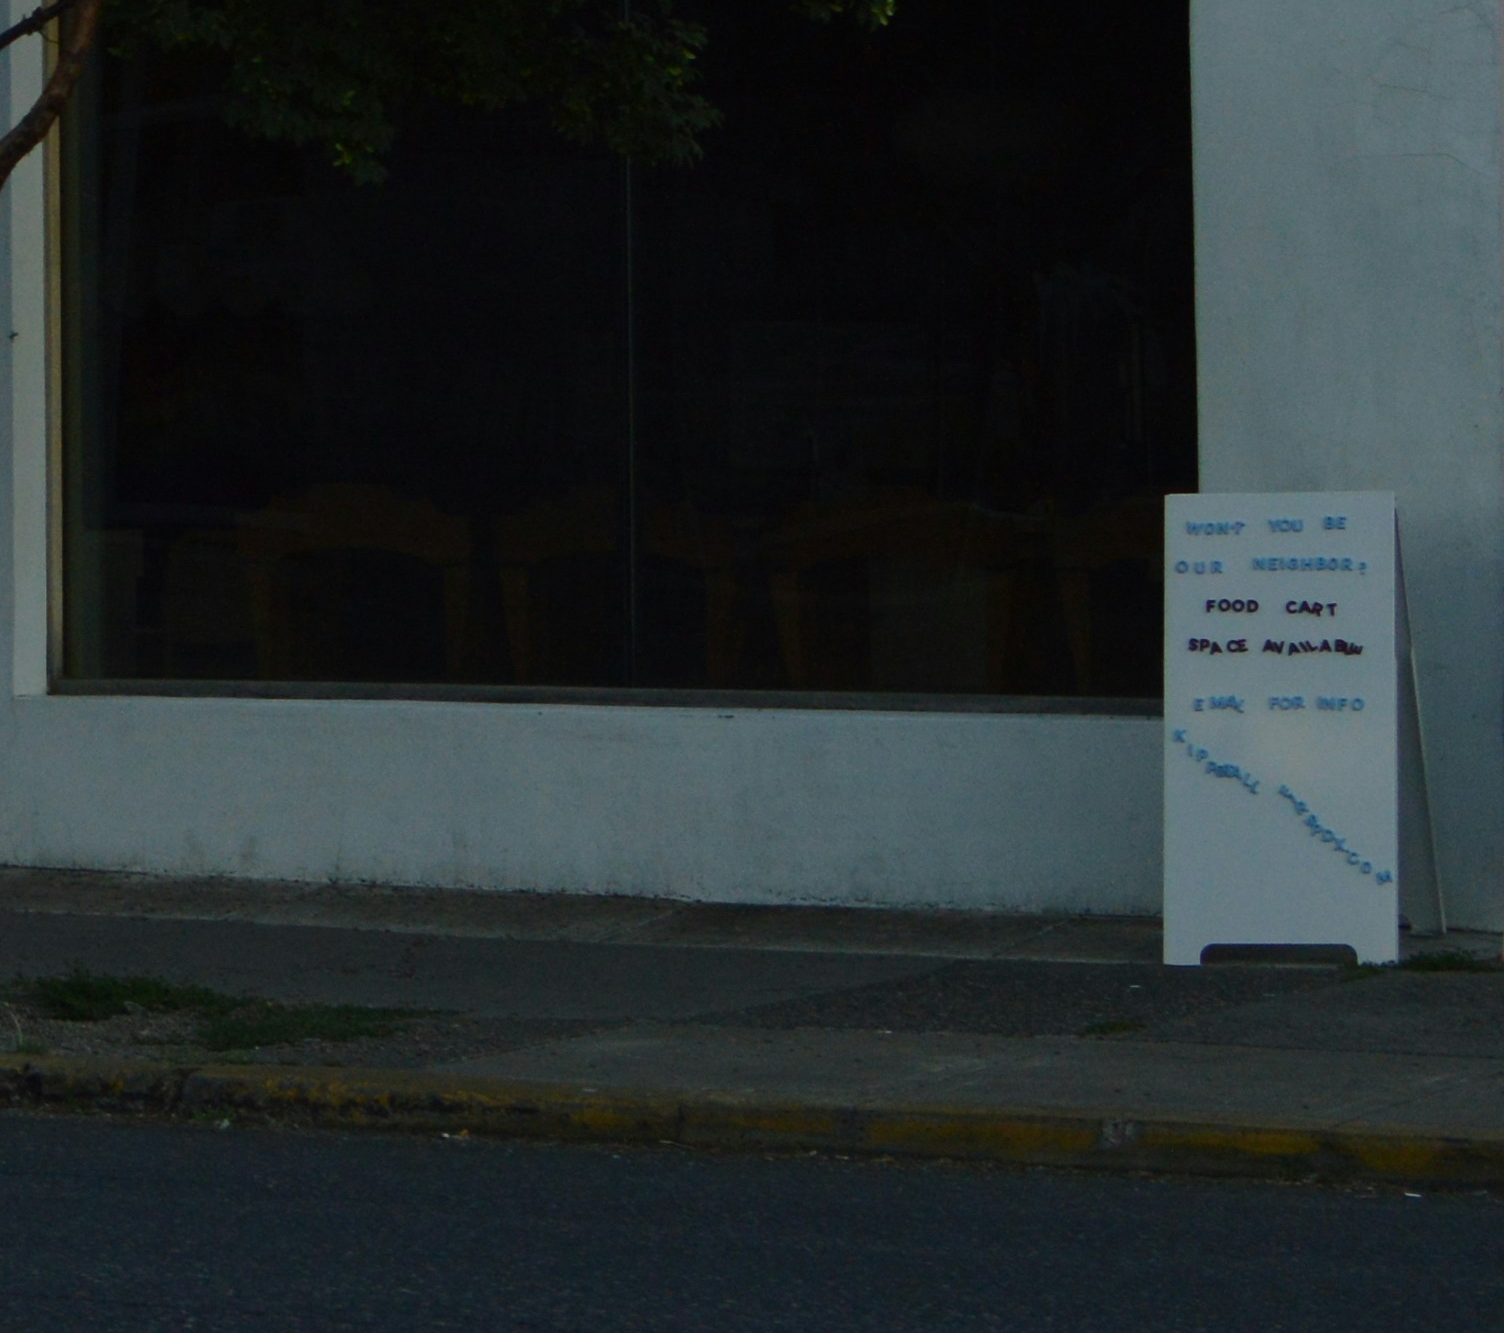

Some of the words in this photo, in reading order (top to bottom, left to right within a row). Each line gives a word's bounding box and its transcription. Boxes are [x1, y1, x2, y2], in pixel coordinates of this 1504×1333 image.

[1267, 517, 1304, 533] YOU
[1322, 516, 1347, 531] BE
[1174, 560, 1224, 575] OUR
[1251, 557, 1368, 576] NEIGHBOR?
[1205, 599, 1260, 614] FOOD
[1285, 600, 1338, 617] CART
[1188, 638, 1249, 654] SPACE
[1268, 696, 1306, 711] FOR
[1316, 696, 1366, 712] INFO
